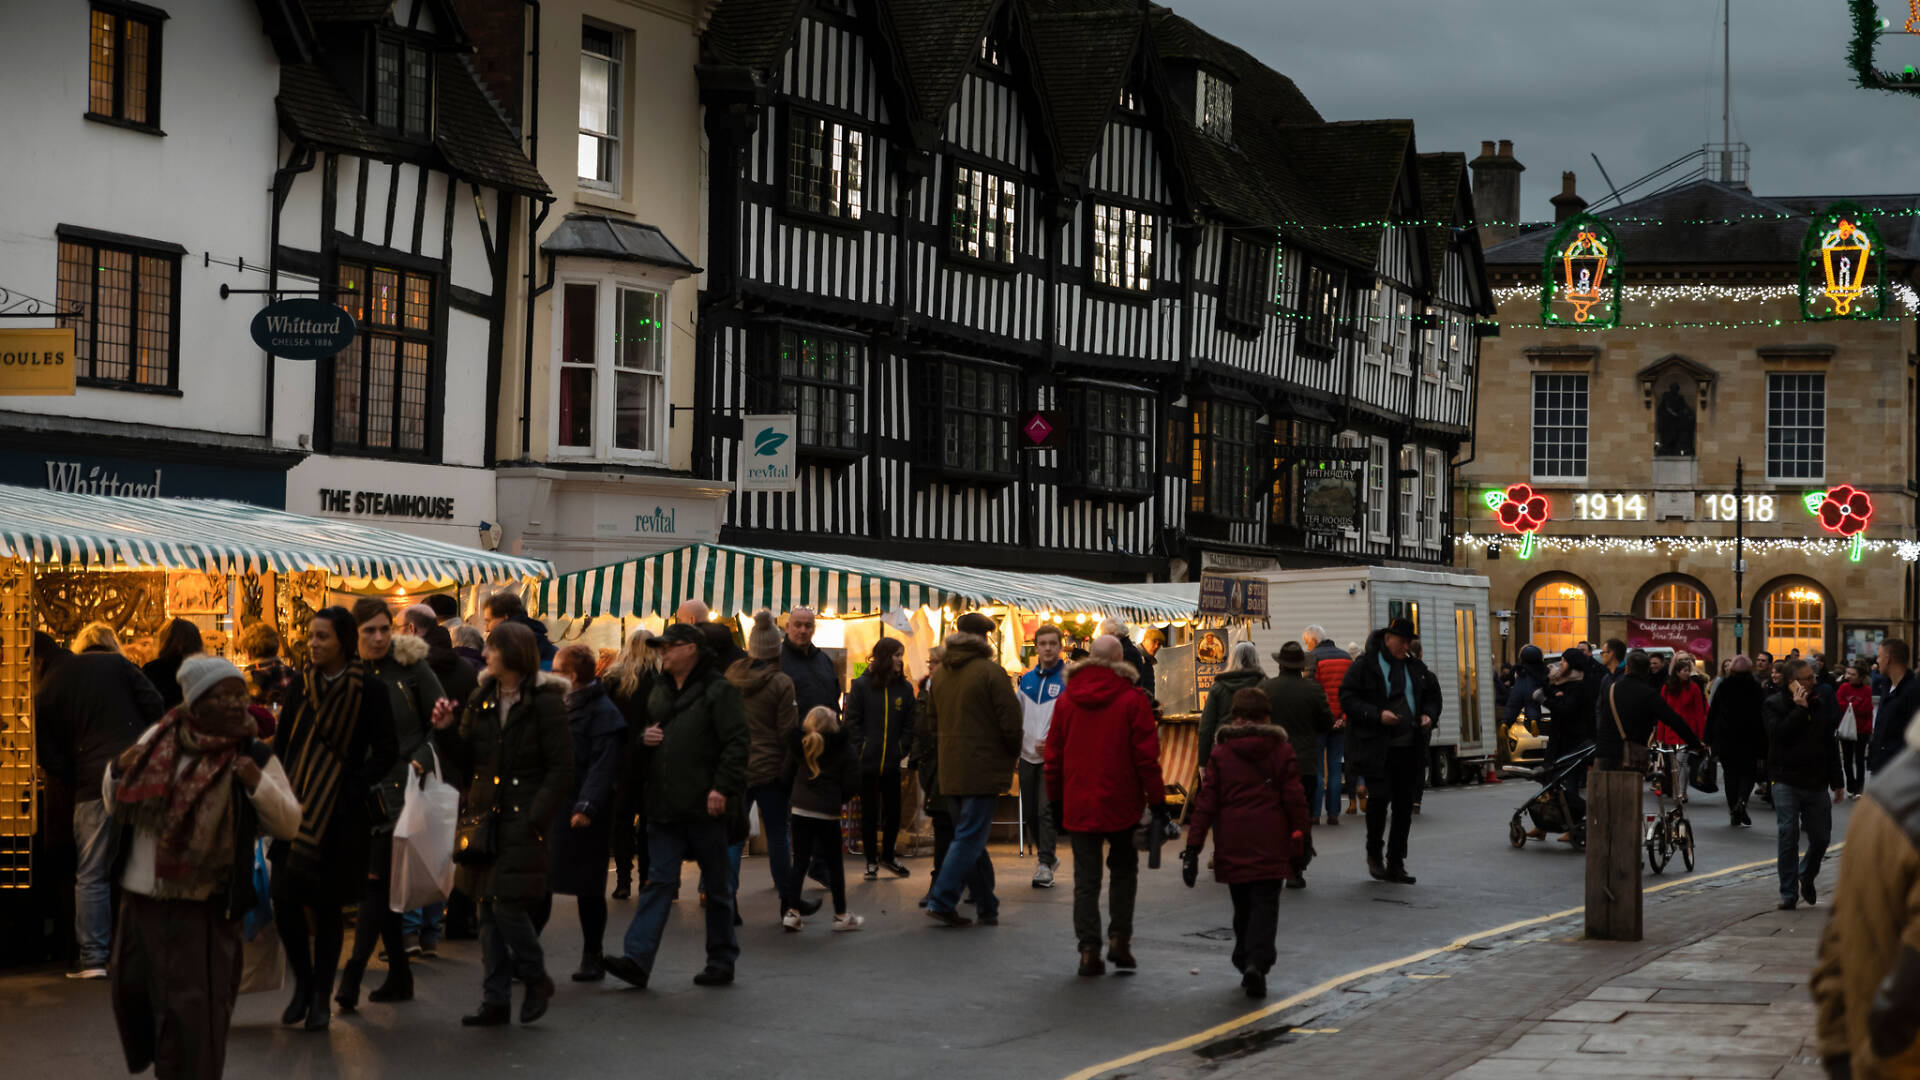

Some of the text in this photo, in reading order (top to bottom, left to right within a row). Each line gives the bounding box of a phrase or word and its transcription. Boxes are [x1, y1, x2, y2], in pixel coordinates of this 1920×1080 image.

[265, 316, 340, 334] Whittard
[271, 338, 311, 346] CHELSEA
[0, 352, 64, 366] OULES
[45, 460, 162, 499] Whittard
[749, 464, 788, 478] revital
[1306, 468, 1355, 480] HATHAWAY
[319, 488, 455, 519] THE STEAMHOUSE
[1575, 493, 1774, 521] 1914 1918
[634, 506, 676, 534] revital
